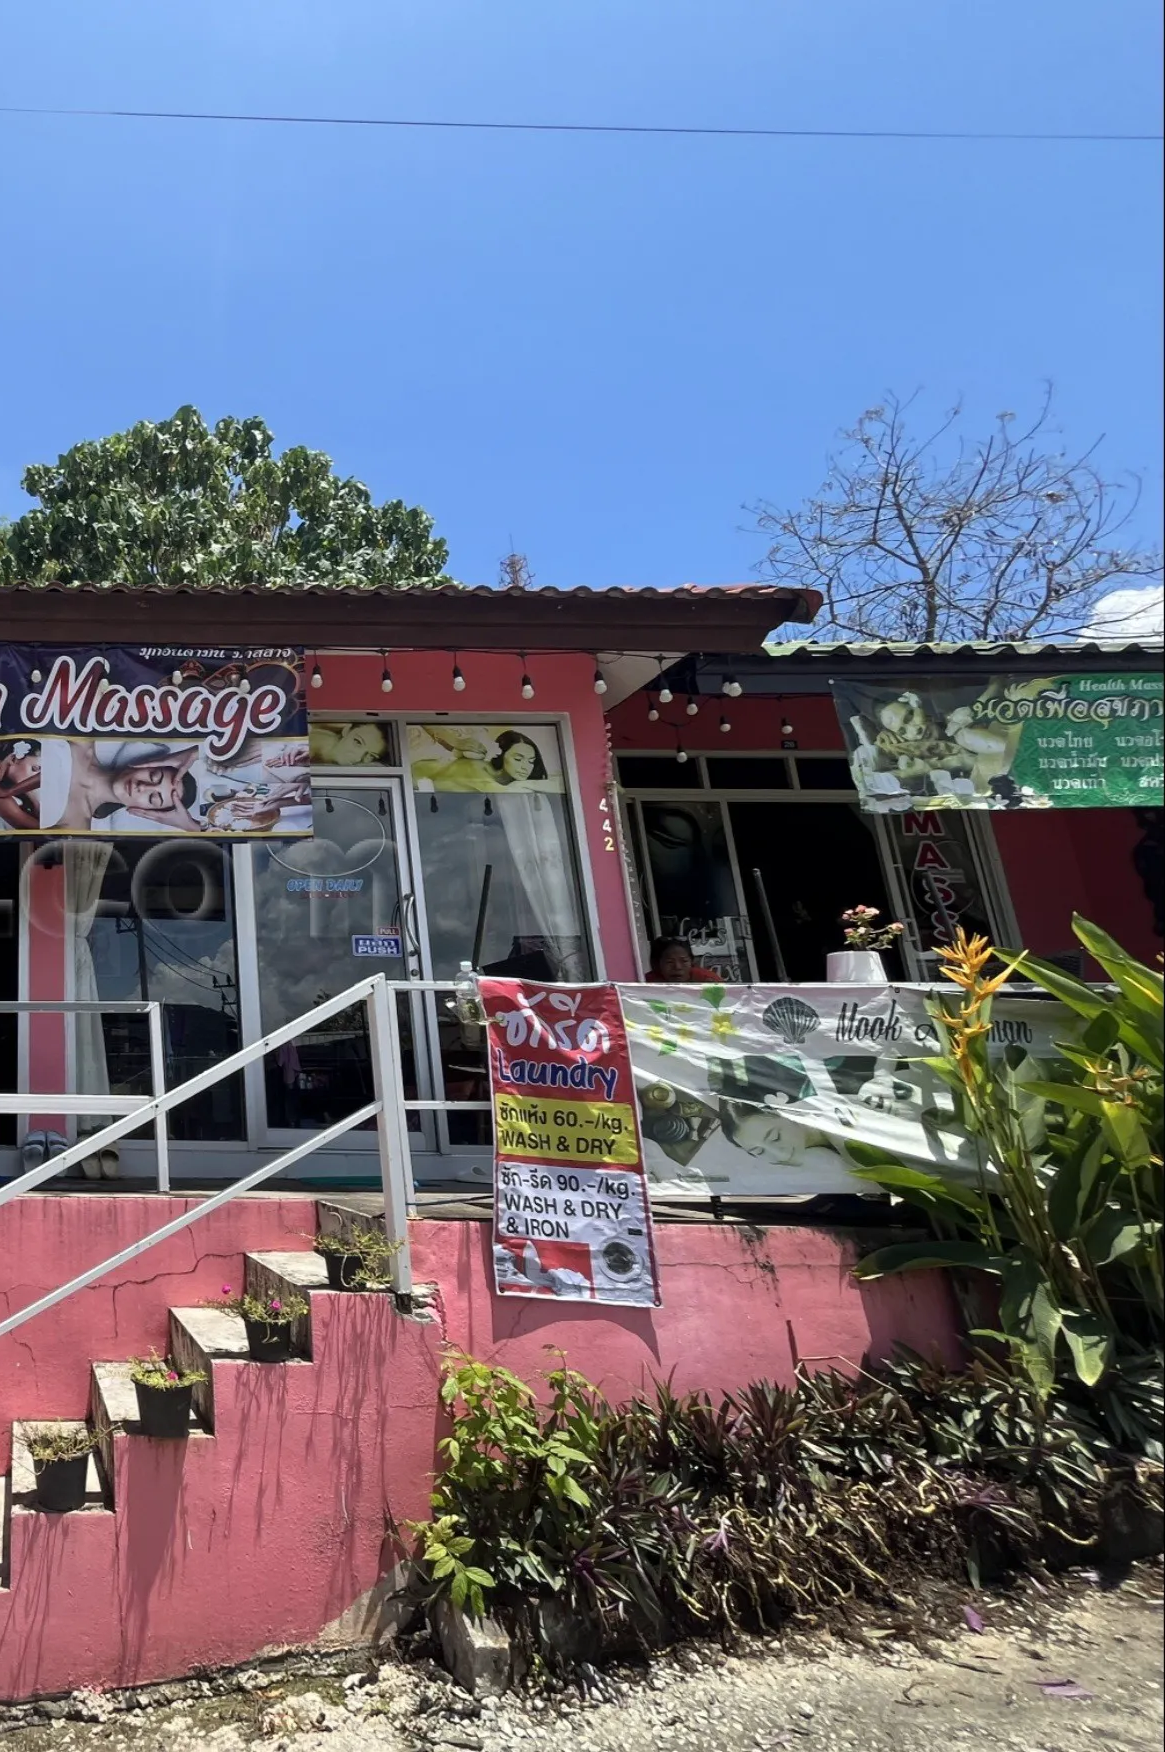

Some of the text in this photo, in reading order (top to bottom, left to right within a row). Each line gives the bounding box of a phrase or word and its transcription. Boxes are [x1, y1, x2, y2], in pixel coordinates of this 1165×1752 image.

[1079, 679, 1125, 691] Health
[21, 655, 286, 761] Massage
[598, 797, 615, 852] 442
[287, 879, 363, 892] OPEN DAILY
[358, 946, 398, 955] PUSH
[835, 999, 903, 1043] Mook
[497, 1048, 618, 1101] Laundry
[500, 1129, 616, 1155] WASH & DRY
[504, 1194, 623, 1220] WASH & DRY
[506, 1216, 569, 1238] & IRON
